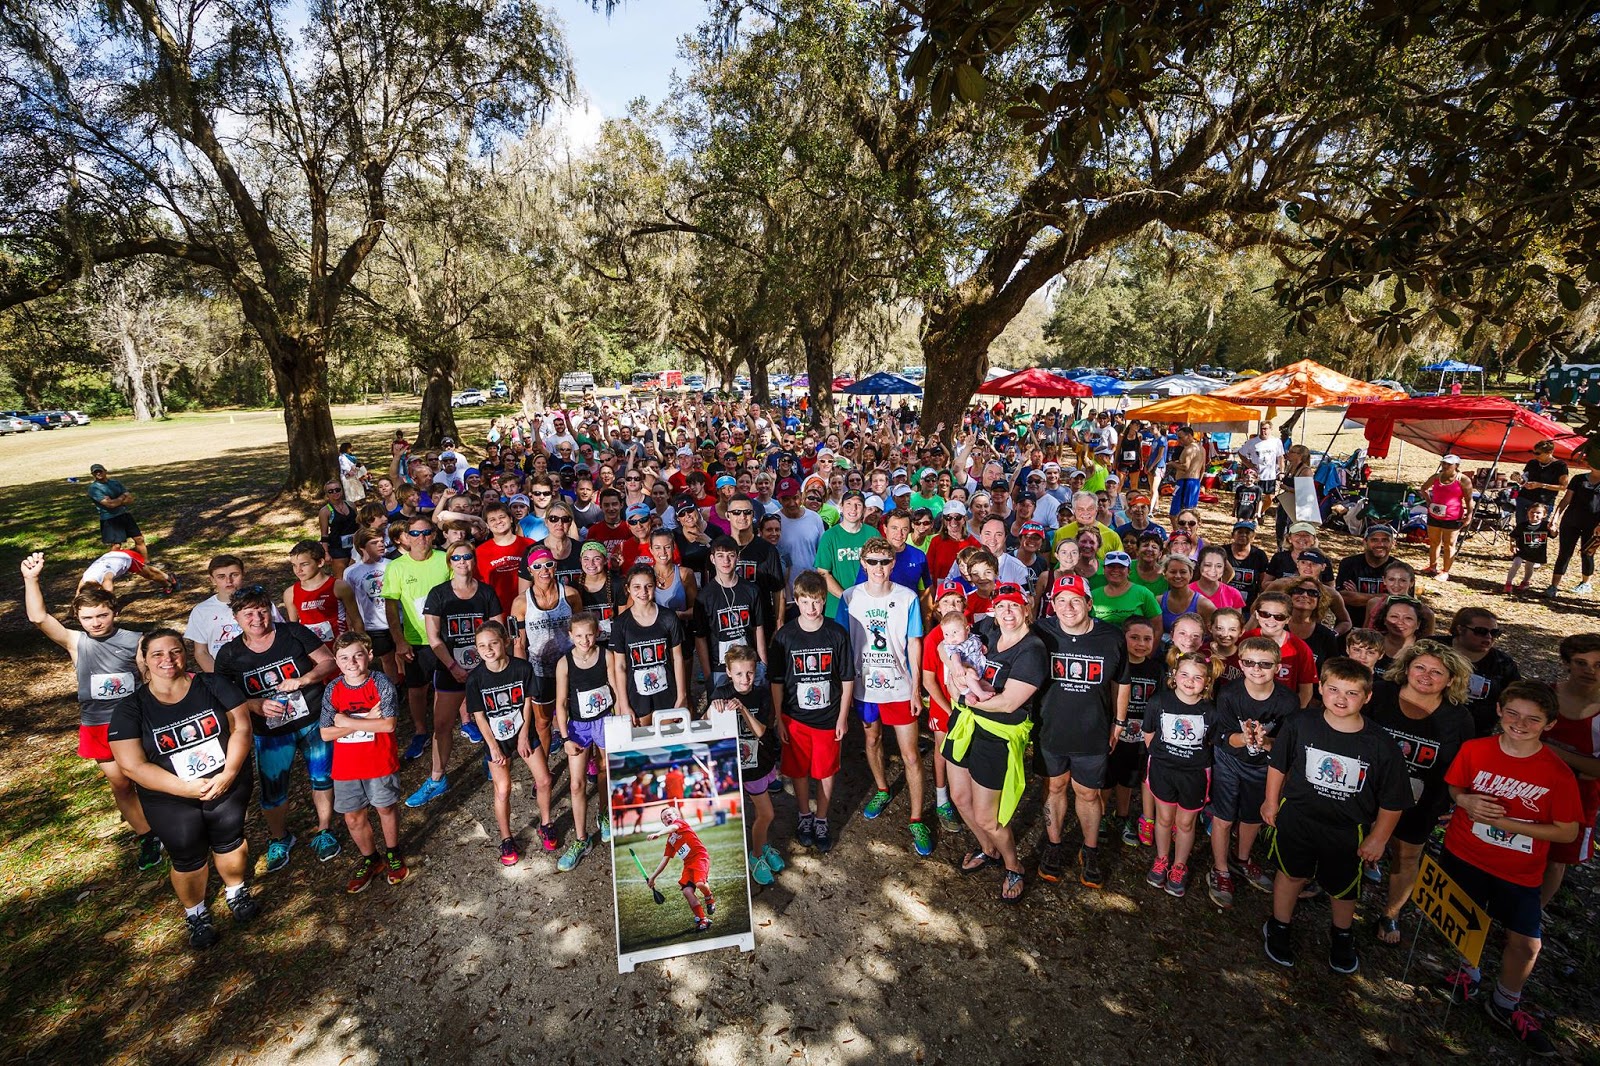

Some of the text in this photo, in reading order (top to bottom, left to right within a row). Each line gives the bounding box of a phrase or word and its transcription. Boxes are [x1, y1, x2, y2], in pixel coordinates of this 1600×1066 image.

[866, 608, 888, 619] TEAM
[1088, 663, 1101, 681] P
[1279, 667, 1290, 677] P
[97, 684, 127, 697] 276
[866, 677, 890, 689] 258
[585, 698, 608, 714] 299
[200, 716, 217, 736] P
[1418, 745, 1436, 763] P
[186, 755, 217, 776] 363
[1473, 783, 1518, 800] TRACK CLUB
[1490, 774, 1550, 801] PLEASANT
[1421, 862, 1449, 900] 5K
[1416, 887, 1467, 947] START
